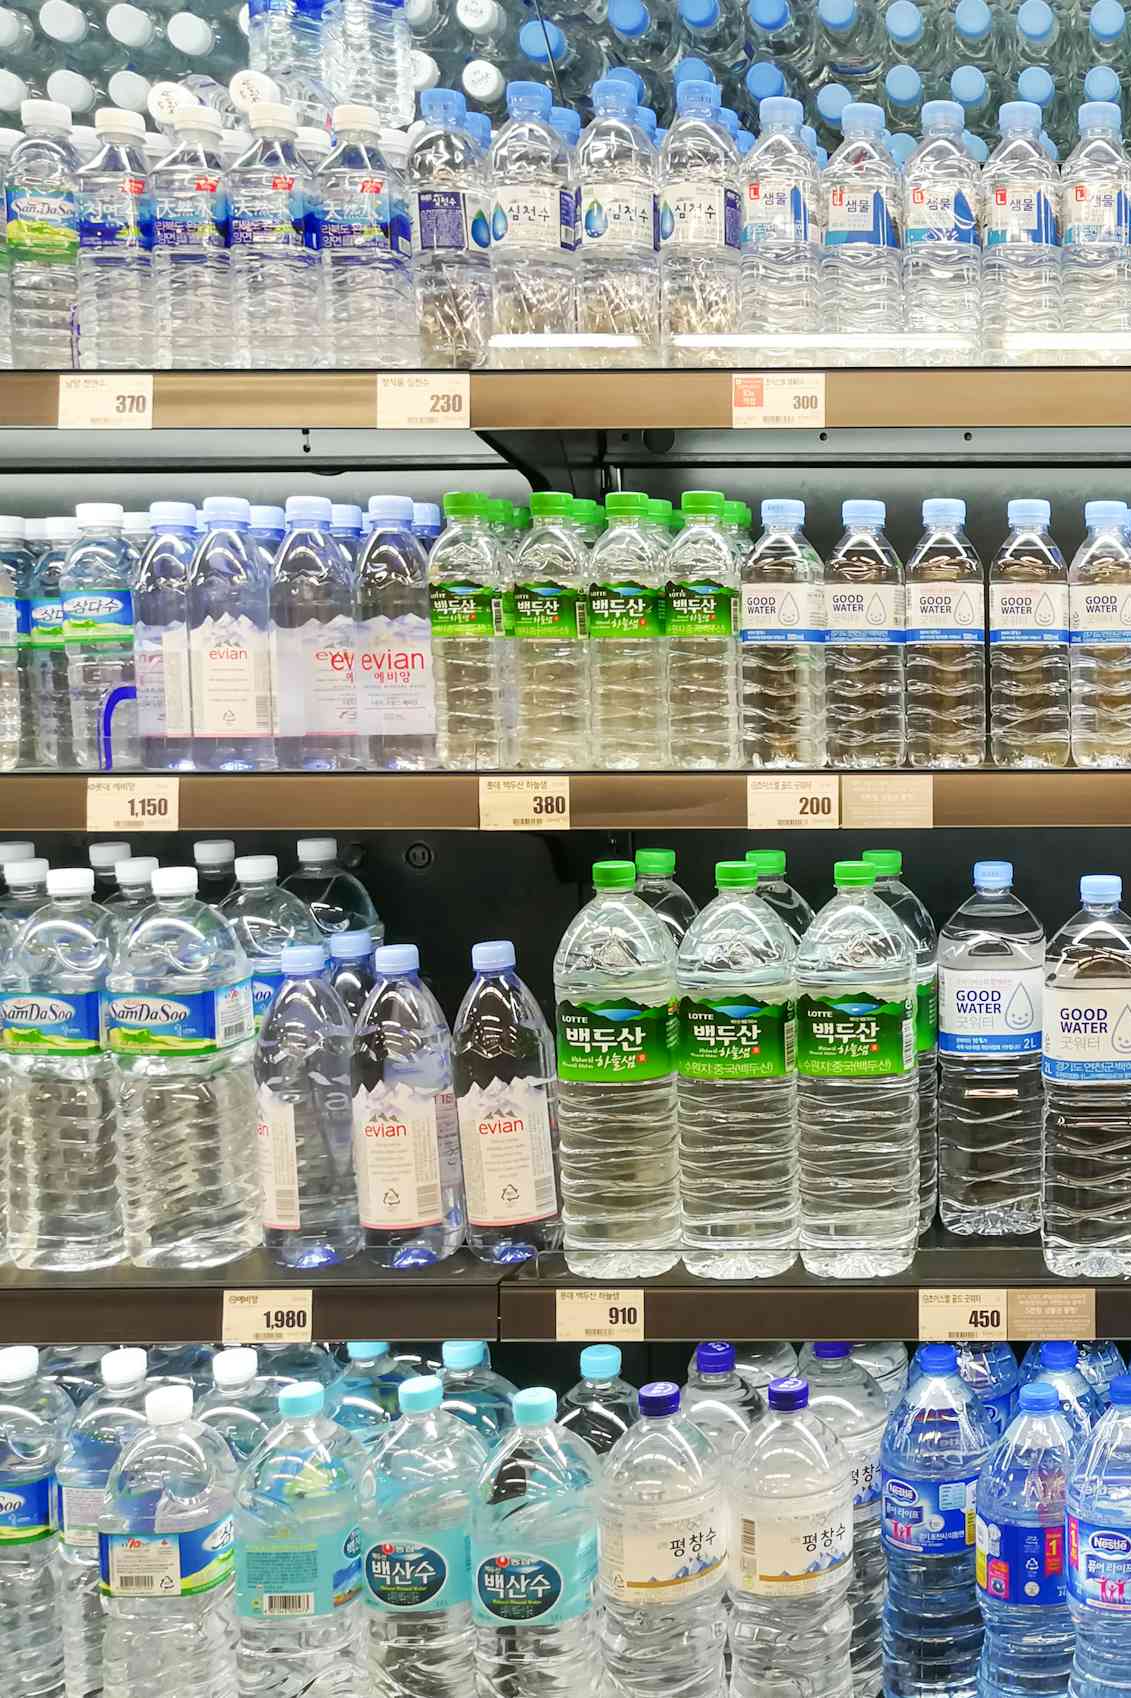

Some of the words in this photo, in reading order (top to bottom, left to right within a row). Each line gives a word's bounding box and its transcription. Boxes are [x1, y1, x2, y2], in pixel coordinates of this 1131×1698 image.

[763, 190, 788, 206] 샘물
[846, 198, 871, 213] 샘물
[1009, 198, 1034, 212] 샘물
[507, 204, 551, 222] 심천수
[115, 395, 146, 414] 370
[430, 394, 463, 413] 230
[793, 395, 818, 410] 300
[672, 599, 717, 614] 백두산
[746, 596, 776, 606] GOOD
[832, 594, 864, 604] GOOD
[919, 596, 952, 606] GOOD
[1001, 597, 1032, 606] GOOD
[1085, 596, 1117, 605] GOOD
[71, 599, 119, 616] 삼다수
[433, 600, 476, 615] 백두산
[517, 600, 560, 616] 백두산
[592, 599, 646, 617] 백두산
[747, 606, 777, 615] WATER
[832, 603, 864, 612] WATER
[919, 605, 952, 614] WATER
[1001, 606, 1032, 615] WATER
[1086, 605, 1118, 614] WATER
[208, 648, 248, 660] evian
[361, 649, 425, 670] evian
[373, 671, 411, 683] 에비양
[127, 798, 168, 818] 1,150
[533, 796, 566, 814] 380
[799, 796, 832, 815] 200
[956, 990, 1001, 1002] GOOD
[110, 1003, 187, 1021] SamDaSoo
[956, 1003, 1001, 1014] WATER
[1060, 1008, 1108, 1021] GOOD
[693, 1024, 762, 1047] 백두산
[812, 1023, 880, 1043] 백두산
[1060, 1022, 1108, 1034] WATER
[566, 1026, 646, 1053] 백두산
[1023, 1038, 1037, 1049] 2L
[595, 1054, 636, 1072] 하늘샘
[364, 1122, 407, 1137] evian
[478, 1119, 524, 1136] evian
[264, 1310, 307, 1330] 1,980
[608, 1307, 637, 1325] 910
[968, 1310, 1001, 1328] 450
[670, 1527, 717, 1558] 평창수
[801, 1523, 847, 1552] 평창수
[372, 1560, 437, 1585] 백산수
[484, 1574, 552, 1599] 백산수
